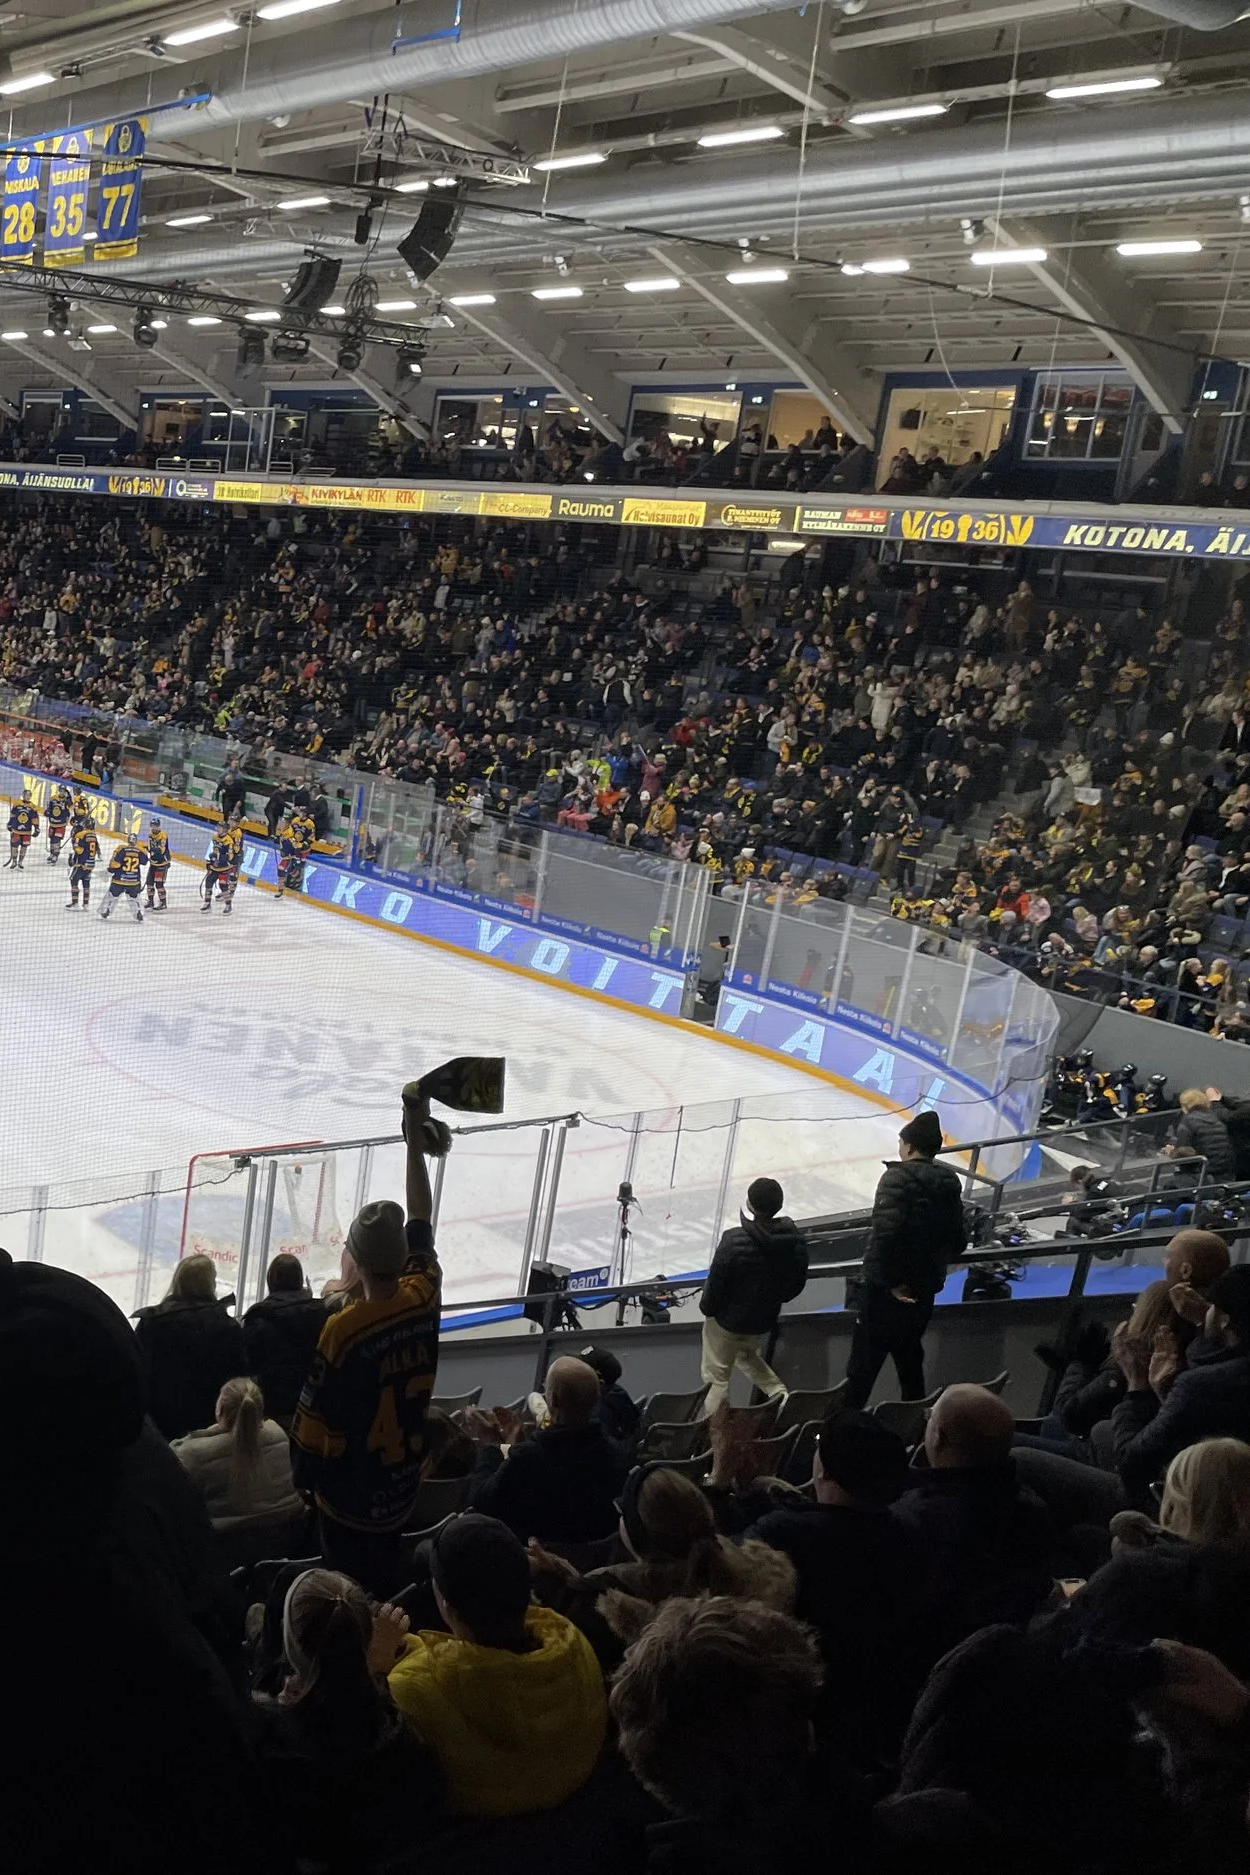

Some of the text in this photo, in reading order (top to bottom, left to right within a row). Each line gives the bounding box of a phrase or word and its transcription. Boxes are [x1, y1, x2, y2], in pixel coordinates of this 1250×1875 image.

[50, 193, 85, 238] 35
[102, 184, 136, 230] 77
[3, 201, 36, 245] 28
[558, 499, 615, 518] Rauma
[803, 510, 842, 520] RAUMAN
[1063, 524, 1195, 554] KOTONA,
[122, 855, 140, 873] 32
